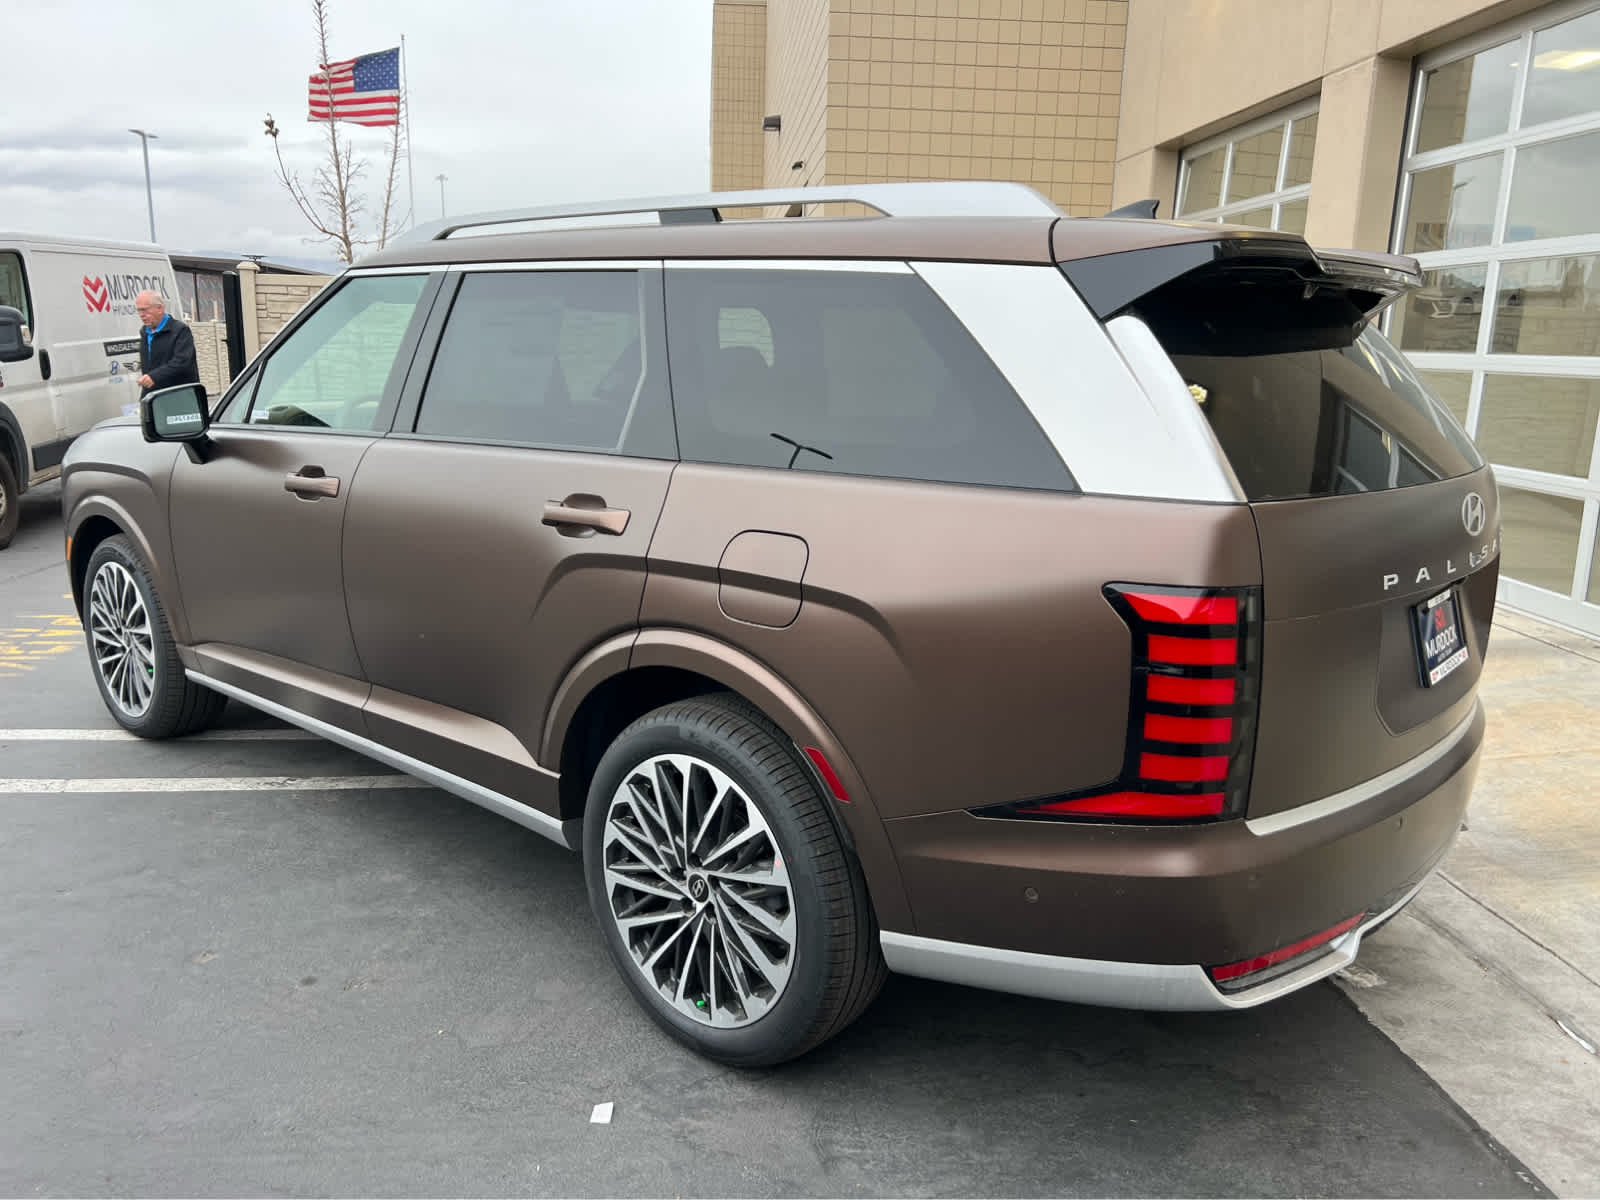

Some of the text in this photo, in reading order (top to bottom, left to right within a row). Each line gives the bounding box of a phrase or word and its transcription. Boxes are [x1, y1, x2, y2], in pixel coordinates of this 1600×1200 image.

[105, 274, 169, 300] MURDOCK
[1384, 539, 1497, 590] PALISA
[1425, 625, 1458, 658] MURDOCK
